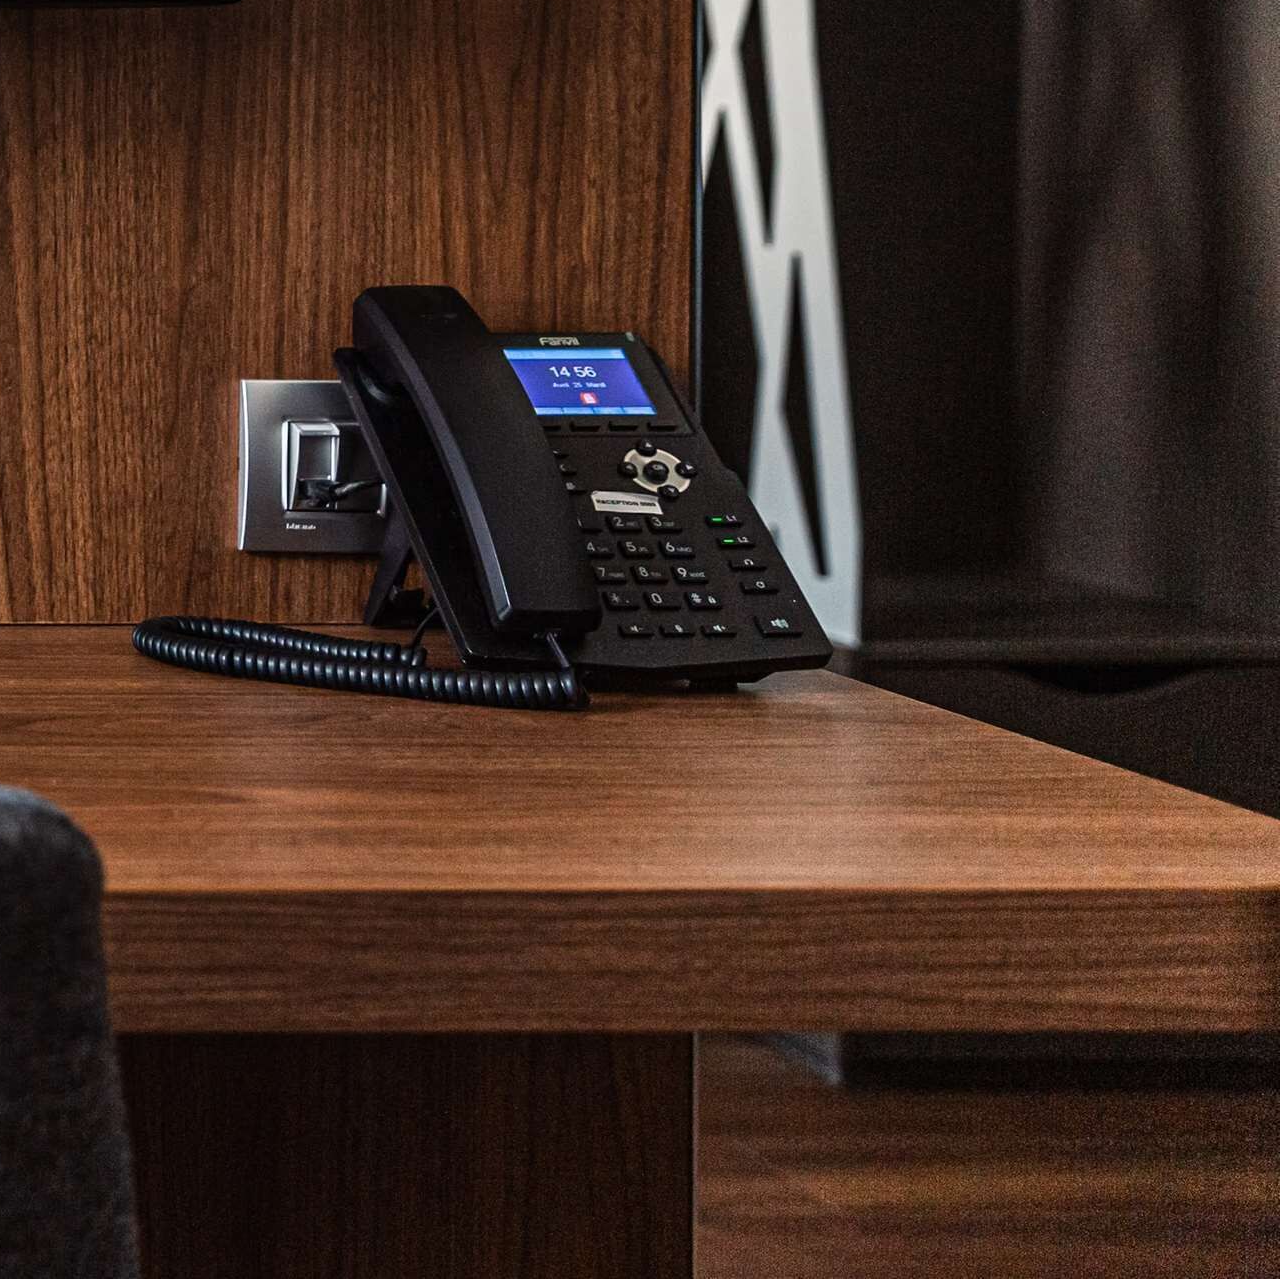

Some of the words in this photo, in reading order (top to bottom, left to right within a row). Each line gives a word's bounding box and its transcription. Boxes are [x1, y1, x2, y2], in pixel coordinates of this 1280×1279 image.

[612, 516, 624, 527] 2
[651, 516, 663, 527] 3
[586, 541, 595, 552] 4
[625, 541, 637, 552] 5
[665, 541, 676, 552] 6
[597, 566, 606, 577] 7
[638, 566, 649, 577] 8
[677, 567, 687, 577] 9
